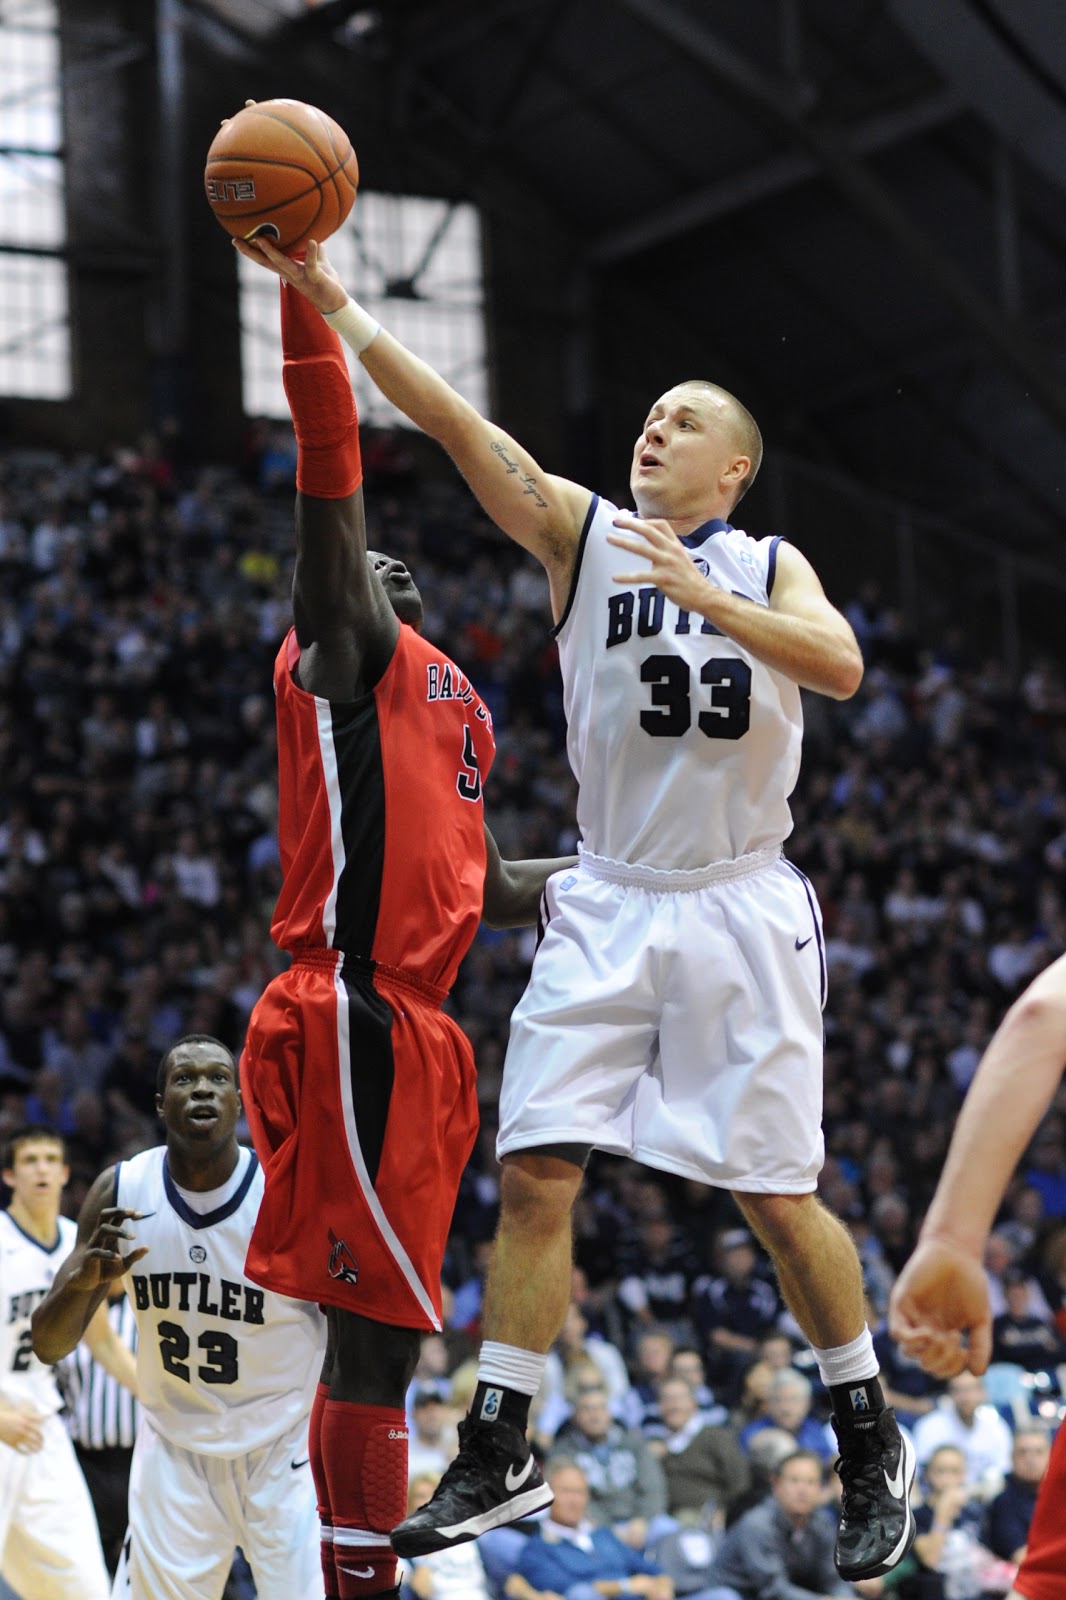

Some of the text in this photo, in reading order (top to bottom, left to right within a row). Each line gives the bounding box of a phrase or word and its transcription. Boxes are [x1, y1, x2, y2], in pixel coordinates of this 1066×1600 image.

[207, 180, 256, 201] ELITE
[519, 473, 548, 508] Legacy
[640, 655, 752, 740] 33
[456, 723, 482, 803] 5
[132, 1272, 265, 1325] BUTLER
[157, 1320, 239, 1384] 23
